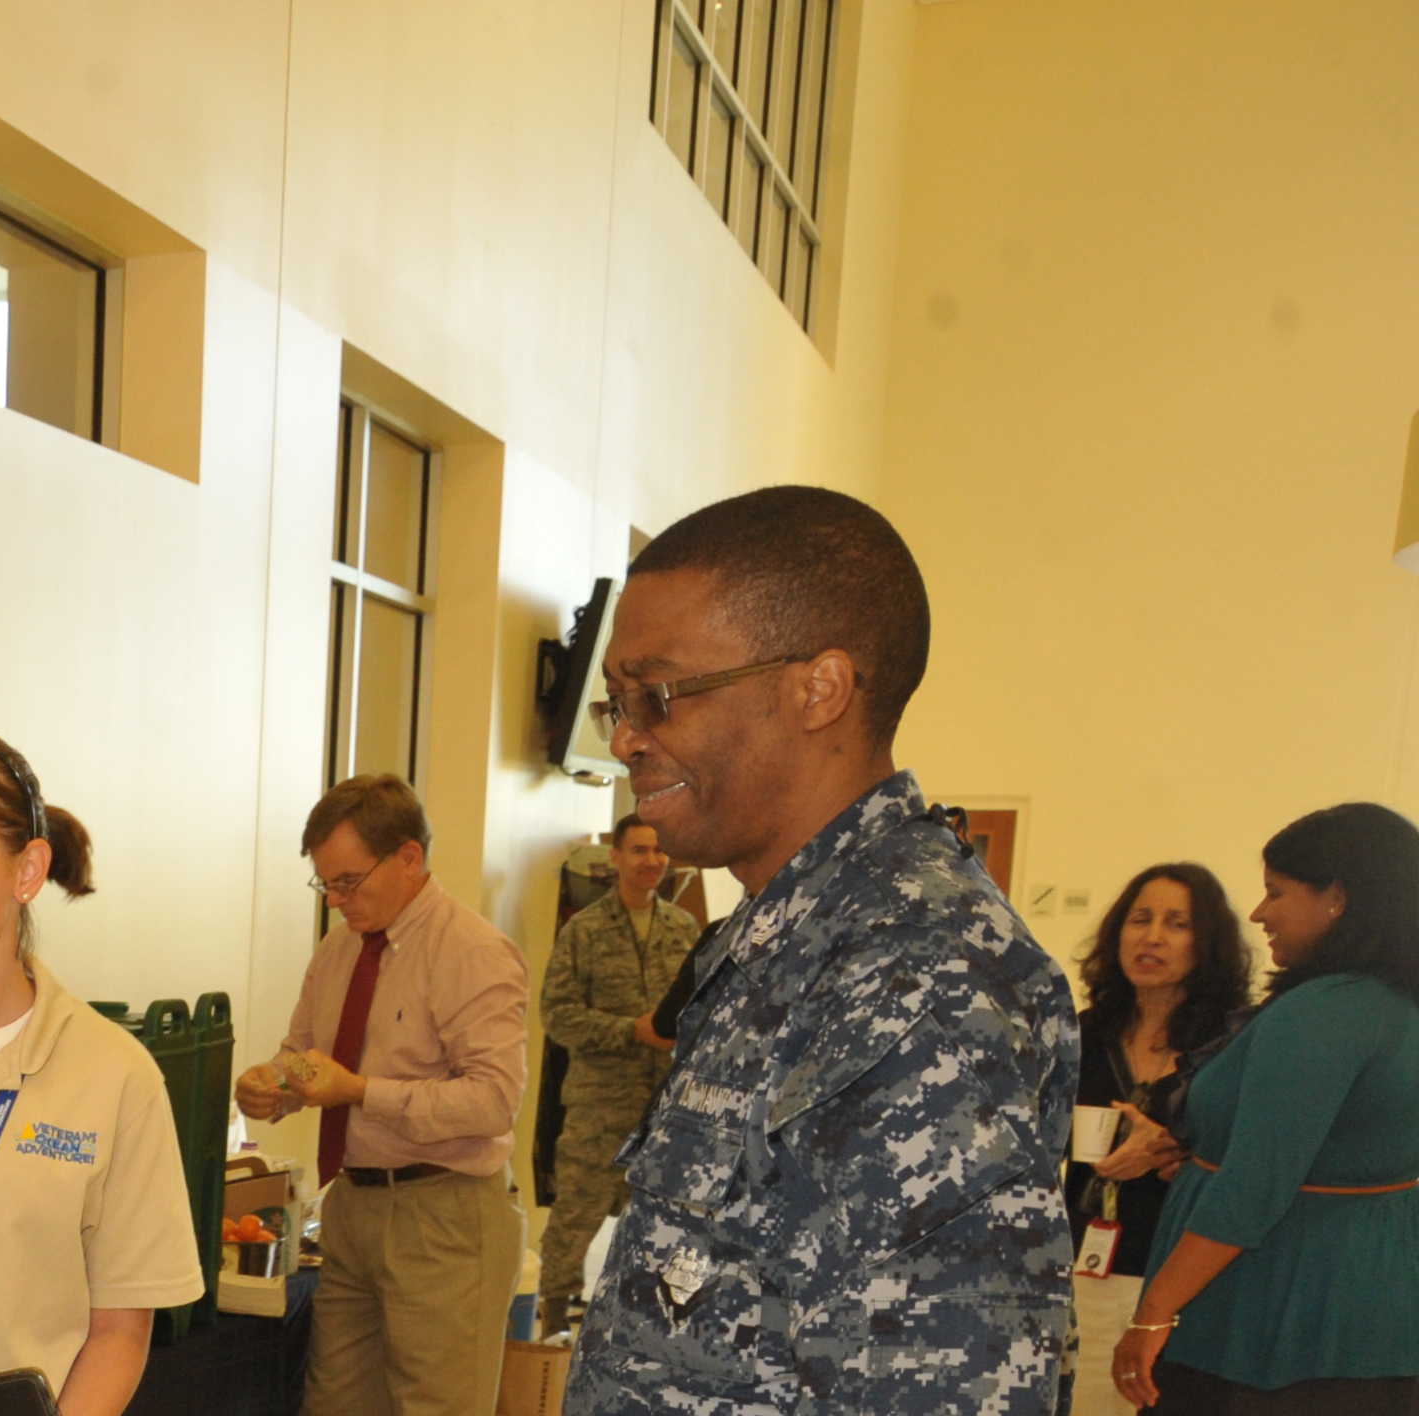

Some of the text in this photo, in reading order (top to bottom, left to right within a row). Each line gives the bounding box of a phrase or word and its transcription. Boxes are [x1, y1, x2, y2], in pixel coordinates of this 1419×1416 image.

[32, 1122, 97, 1144] VETERANS
[35, 1134, 81, 1153] OCEAN
[16, 1143, 95, 1165] ADVENTURES
